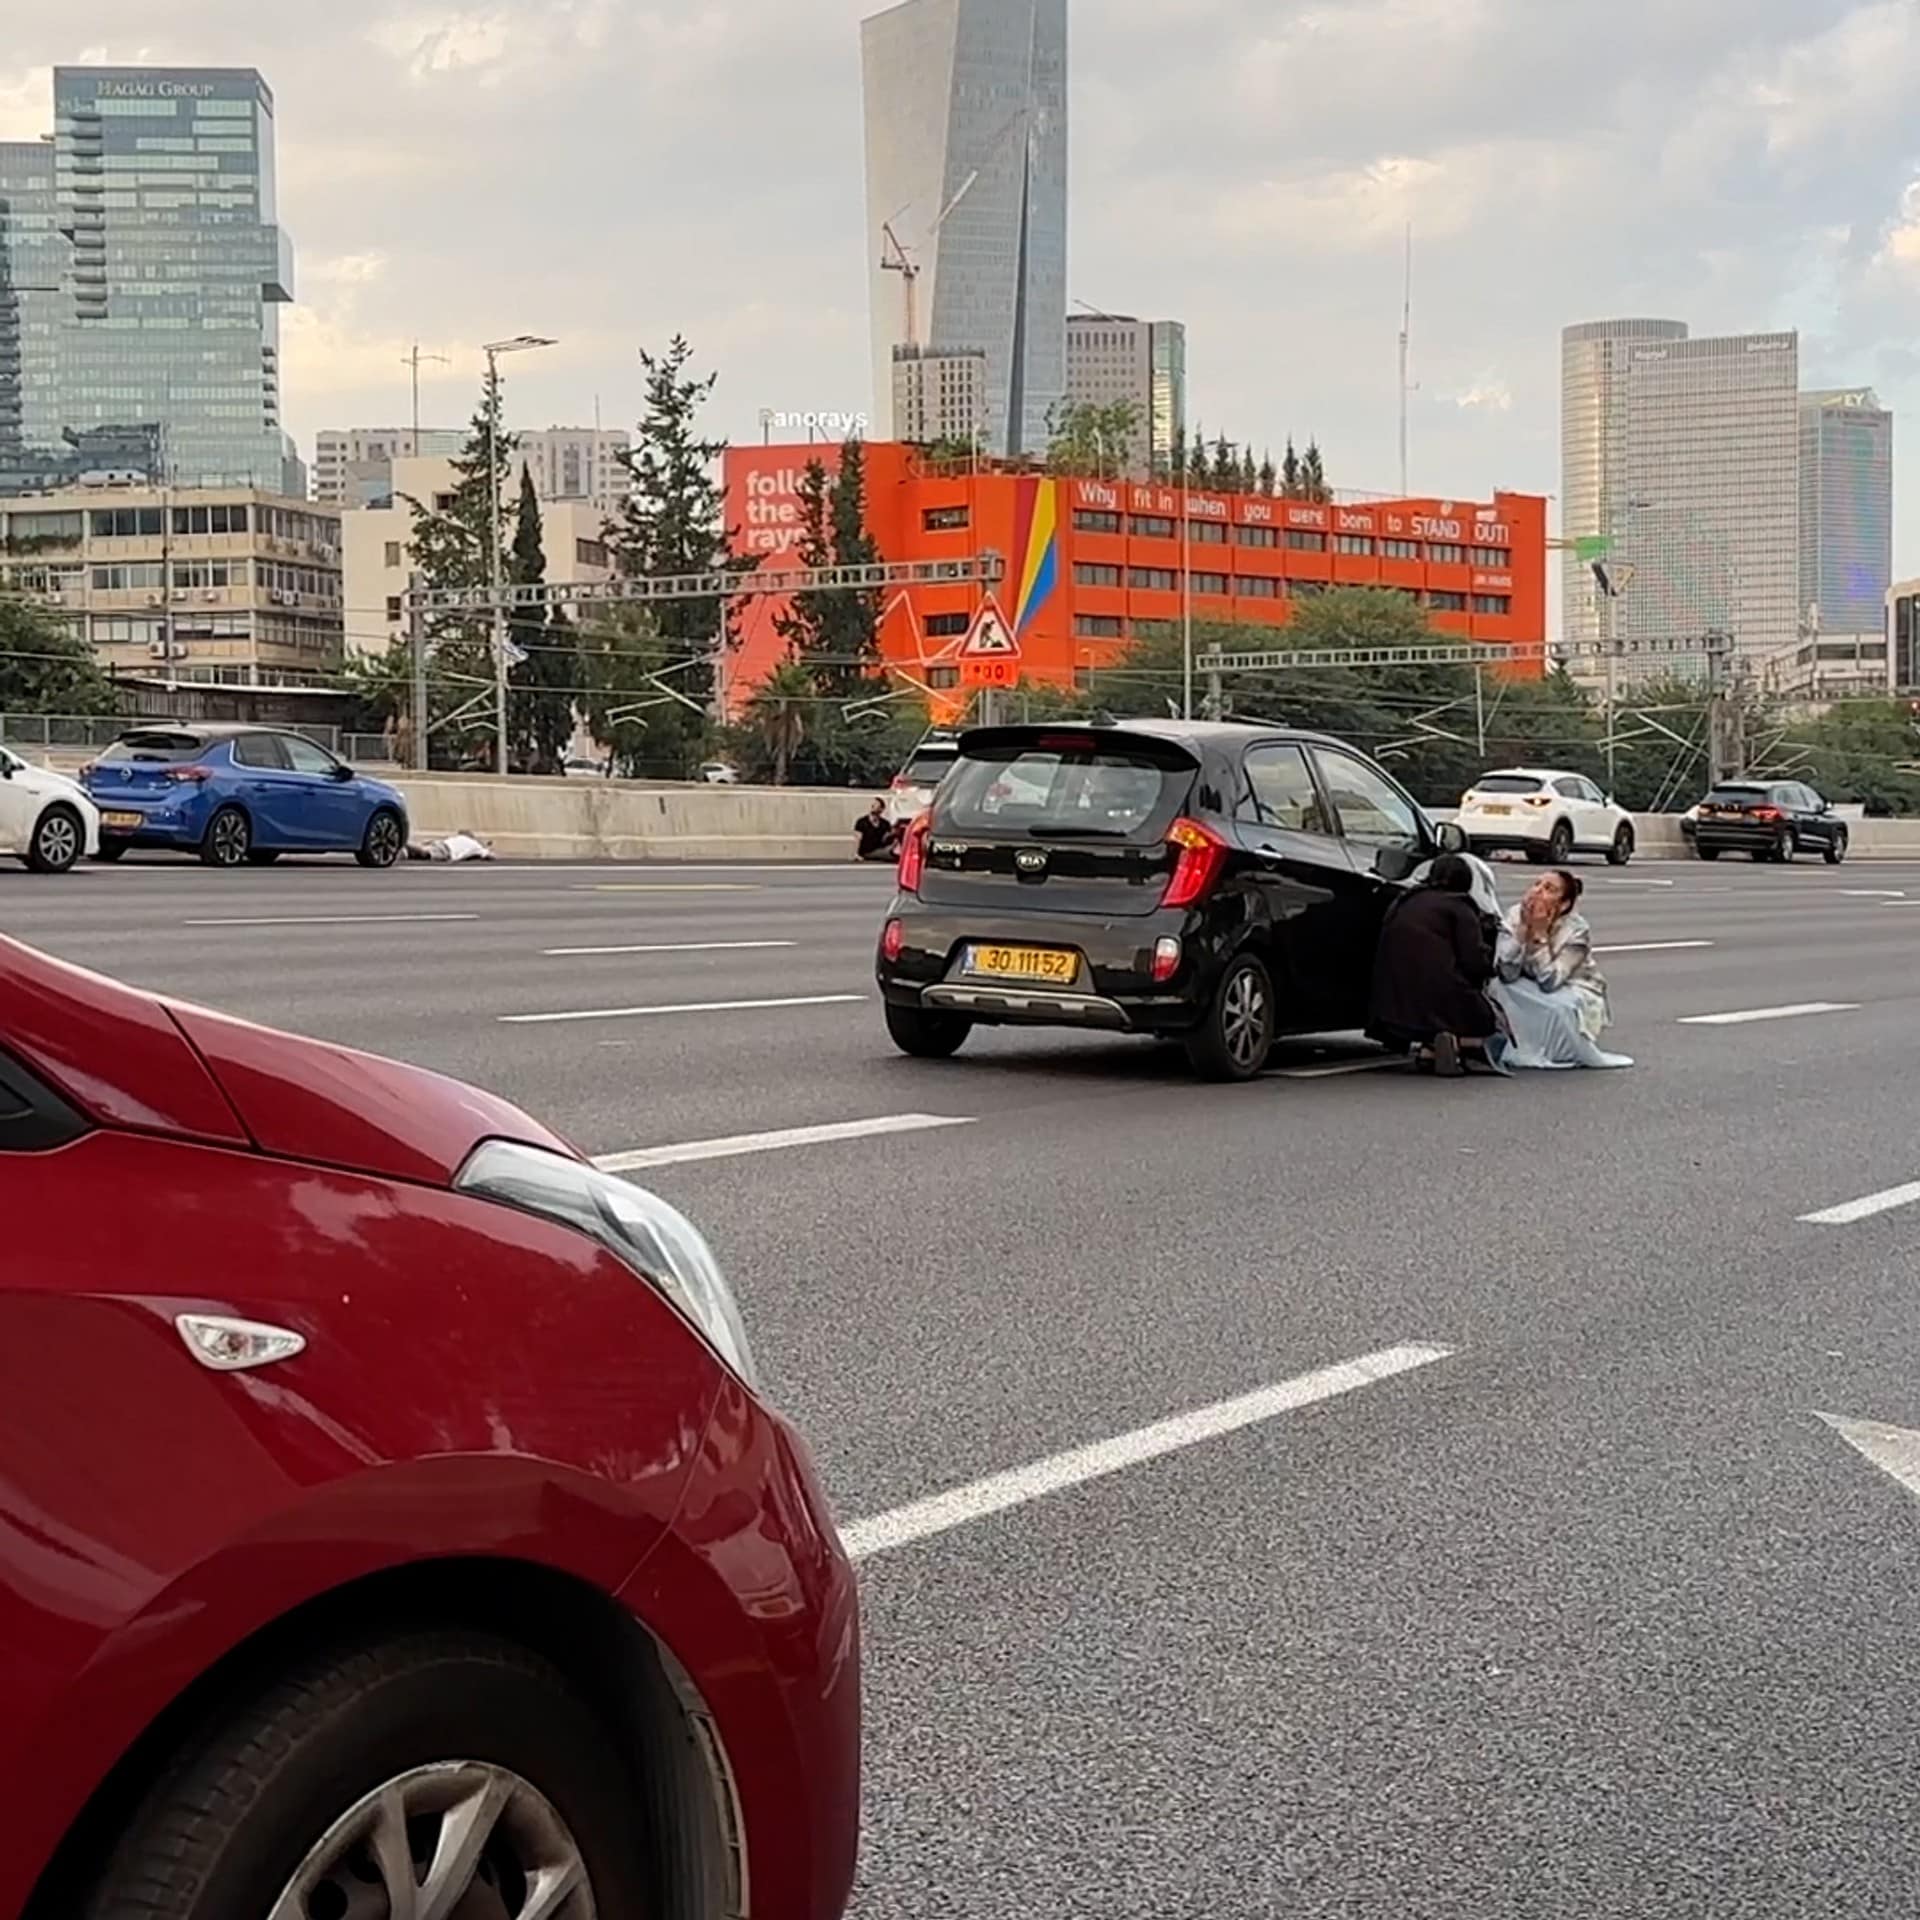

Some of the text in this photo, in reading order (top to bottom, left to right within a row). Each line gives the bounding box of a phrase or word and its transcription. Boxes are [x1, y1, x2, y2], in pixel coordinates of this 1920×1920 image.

[159, 80, 215, 97] GROUP
[746, 498, 796, 523] the
[1079, 481, 1117, 507] Why
[1134, 489, 1152, 508] fit
[1158, 491, 1173, 511] in
[1186, 496, 1226, 516] when
[1244, 504, 1271, 522] you
[1288, 508, 1324, 525] were
[1339, 510, 1372, 530] born
[1388, 515, 1402, 531] to
[1411, 517, 1461, 539] STAND
